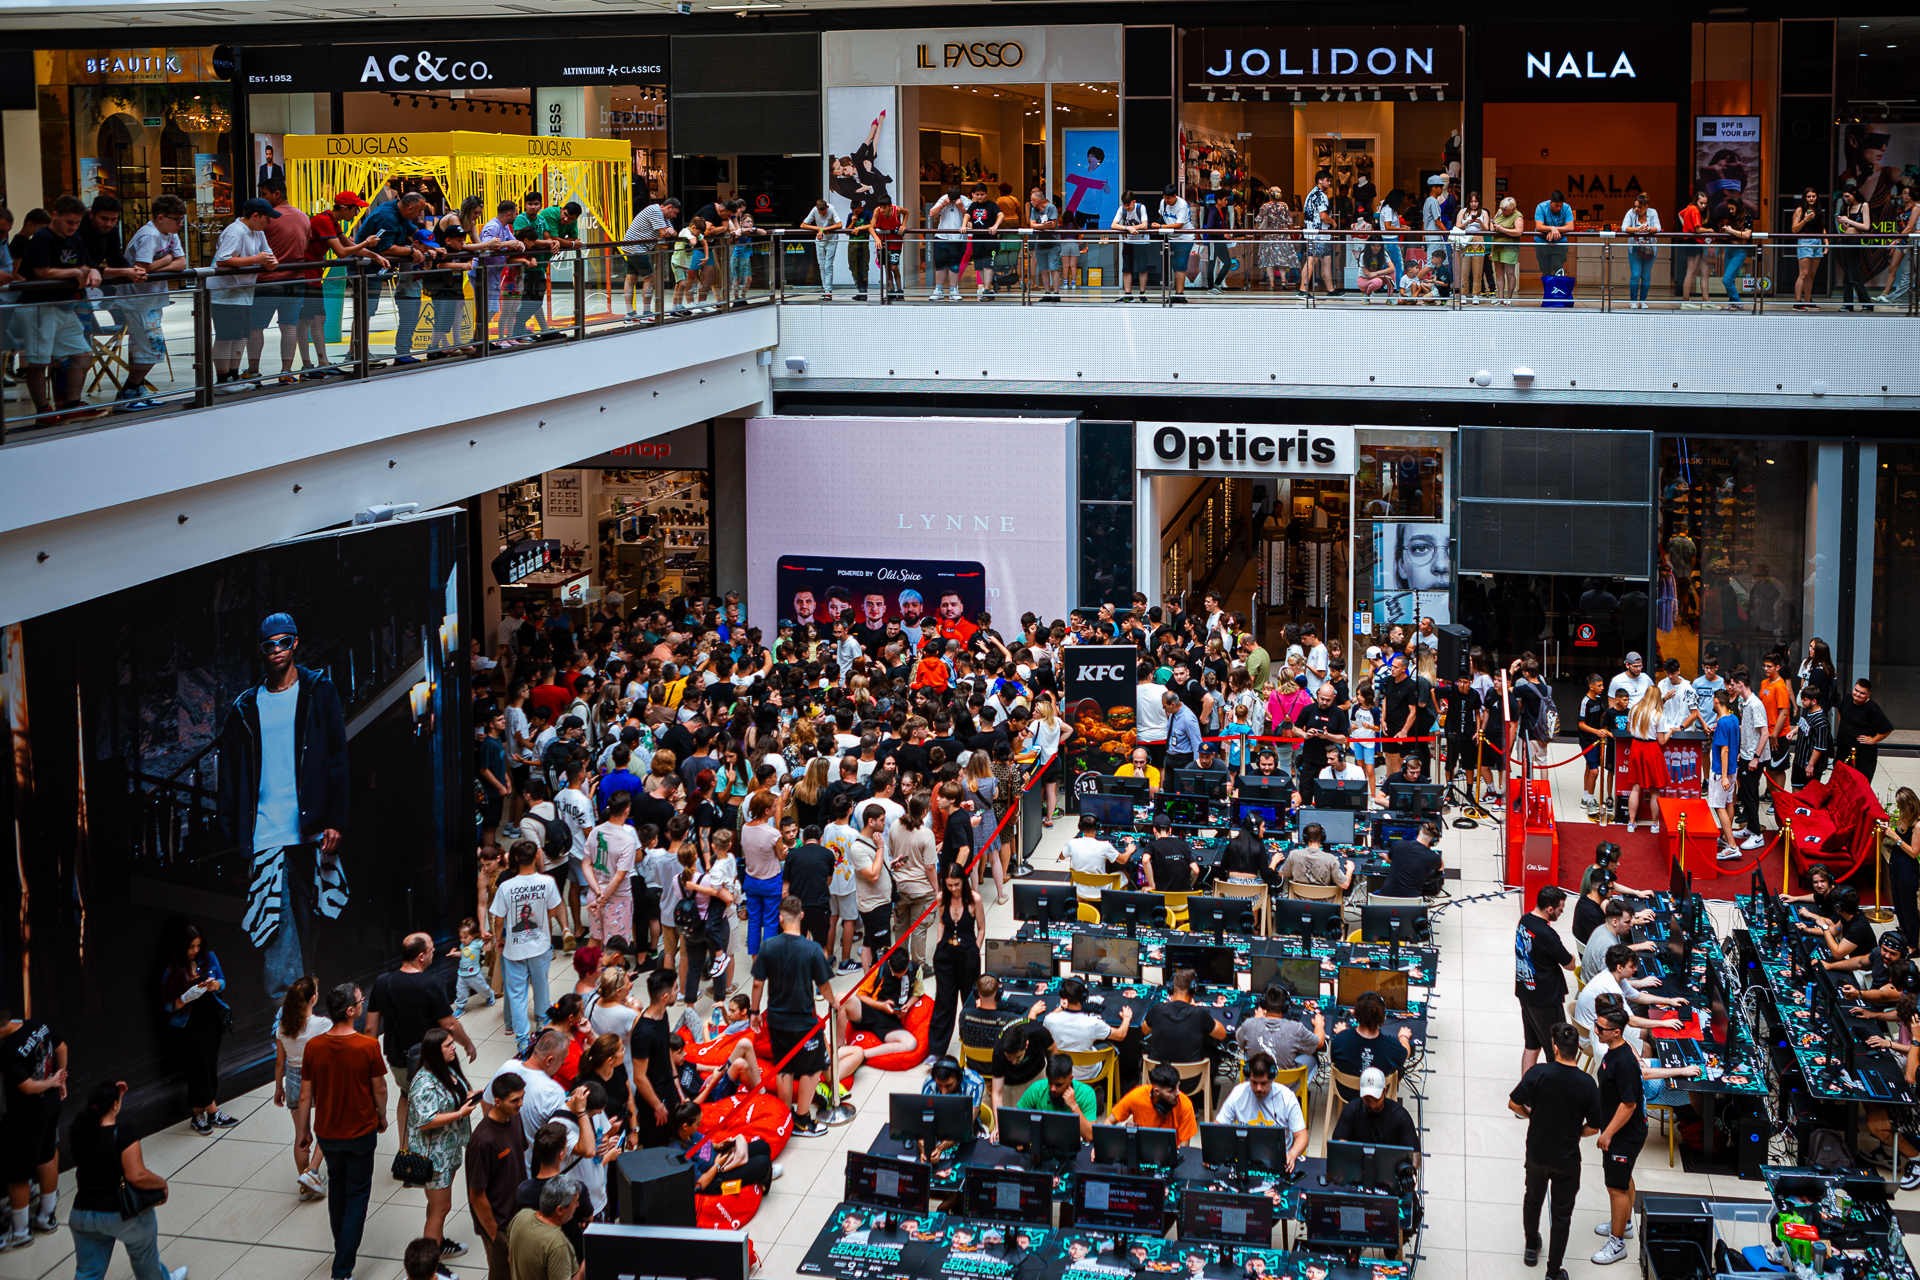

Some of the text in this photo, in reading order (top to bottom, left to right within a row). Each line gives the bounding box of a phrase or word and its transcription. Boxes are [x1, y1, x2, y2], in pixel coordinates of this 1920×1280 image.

[916, 41, 1024, 69] IL PASSO
[1206, 47, 1434, 77] JOLIDON
[86, 56, 182, 74] BEAUTIK
[620, 65, 662, 75] CLASSICS
[1526, 50, 1637, 79] NALA
[269, 74, 292, 83] 1952
[326, 136, 409, 155] DOUGLAS
[528, 139, 572, 157] DOUGLAS
[1567, 174, 1643, 193] NALA
[1152, 426, 1337, 469] Opticris
[897, 513, 1016, 532] LYNNE
[837, 569, 864, 578] POWERED
[865, 570, 874, 578] BY
[877, 567, 897, 581] Old
[897, 568, 923, 583] Spice
[1076, 664, 1126, 682] KFC
[510, 884, 546, 895] LOOK MOM
[514, 893, 530, 902] CAN
[531, 891, 545, 900] FLY
[837, 1242, 901, 1256] CITY PARK
